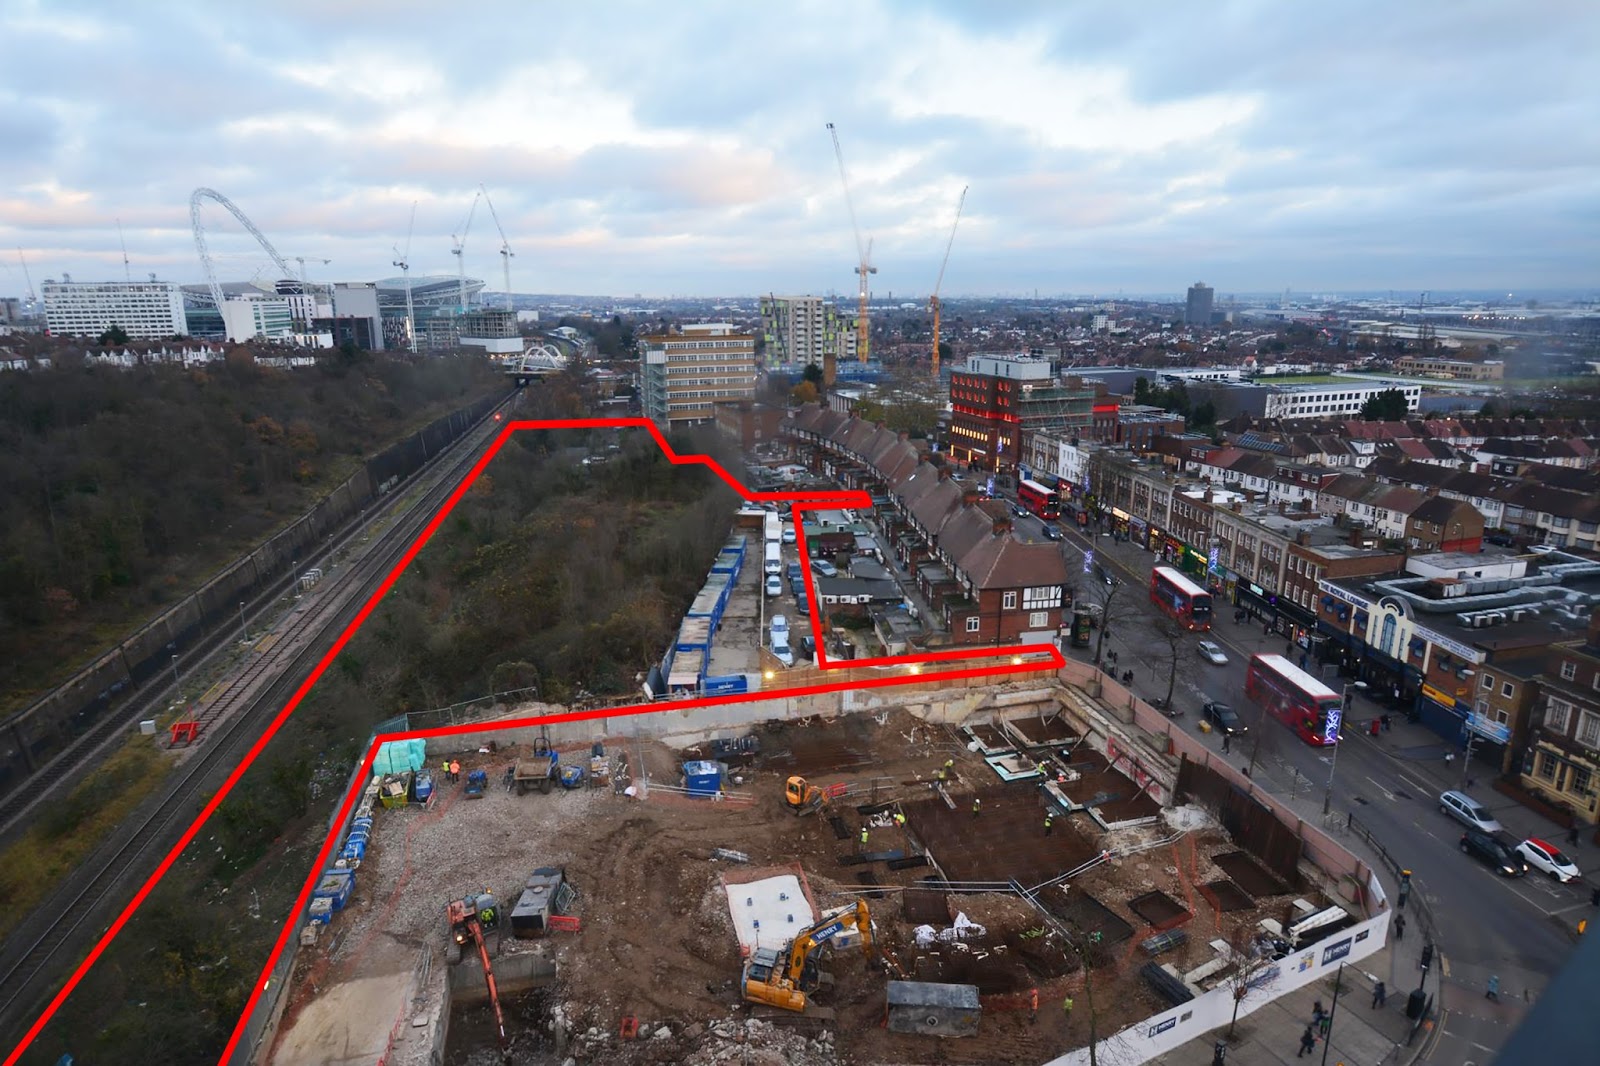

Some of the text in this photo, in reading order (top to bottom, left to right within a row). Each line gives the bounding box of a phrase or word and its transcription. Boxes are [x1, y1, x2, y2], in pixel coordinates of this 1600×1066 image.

[1321, 581, 1332, 591] THE
[1330, 586, 1347, 599] ROYAL
[1346, 594, 1369, 610] LOUNGE
[816, 925, 837, 939] HENRY
[1333, 943, 1351, 955] HENRY
